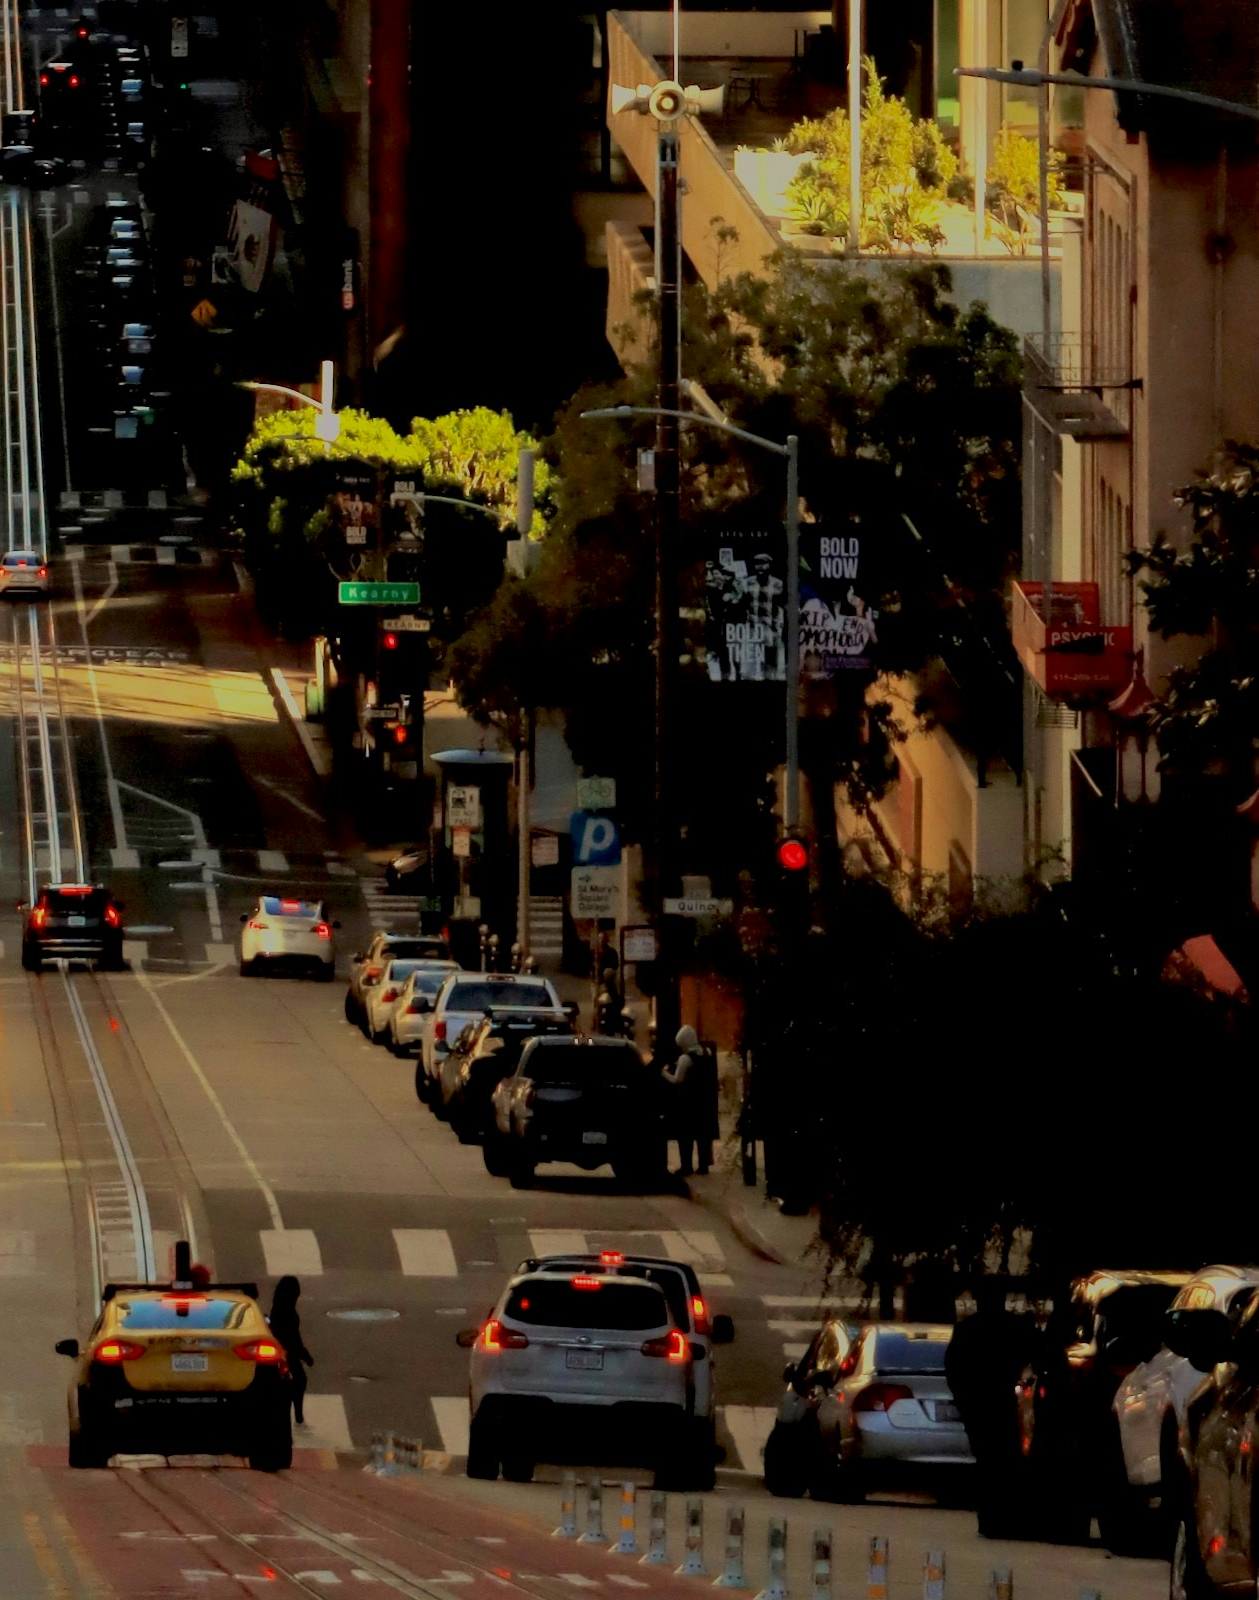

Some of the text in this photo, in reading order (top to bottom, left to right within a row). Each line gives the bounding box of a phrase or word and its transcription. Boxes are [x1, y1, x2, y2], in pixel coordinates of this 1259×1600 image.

[820, 537, 859, 557] BOLD
[820, 558, 858, 579] NOW
[349, 587, 410, 600] Kearny
[726, 623, 763, 642] BOLD
[798, 627, 865, 648] OMOPHOBIA
[726, 643, 765, 663] THEN
